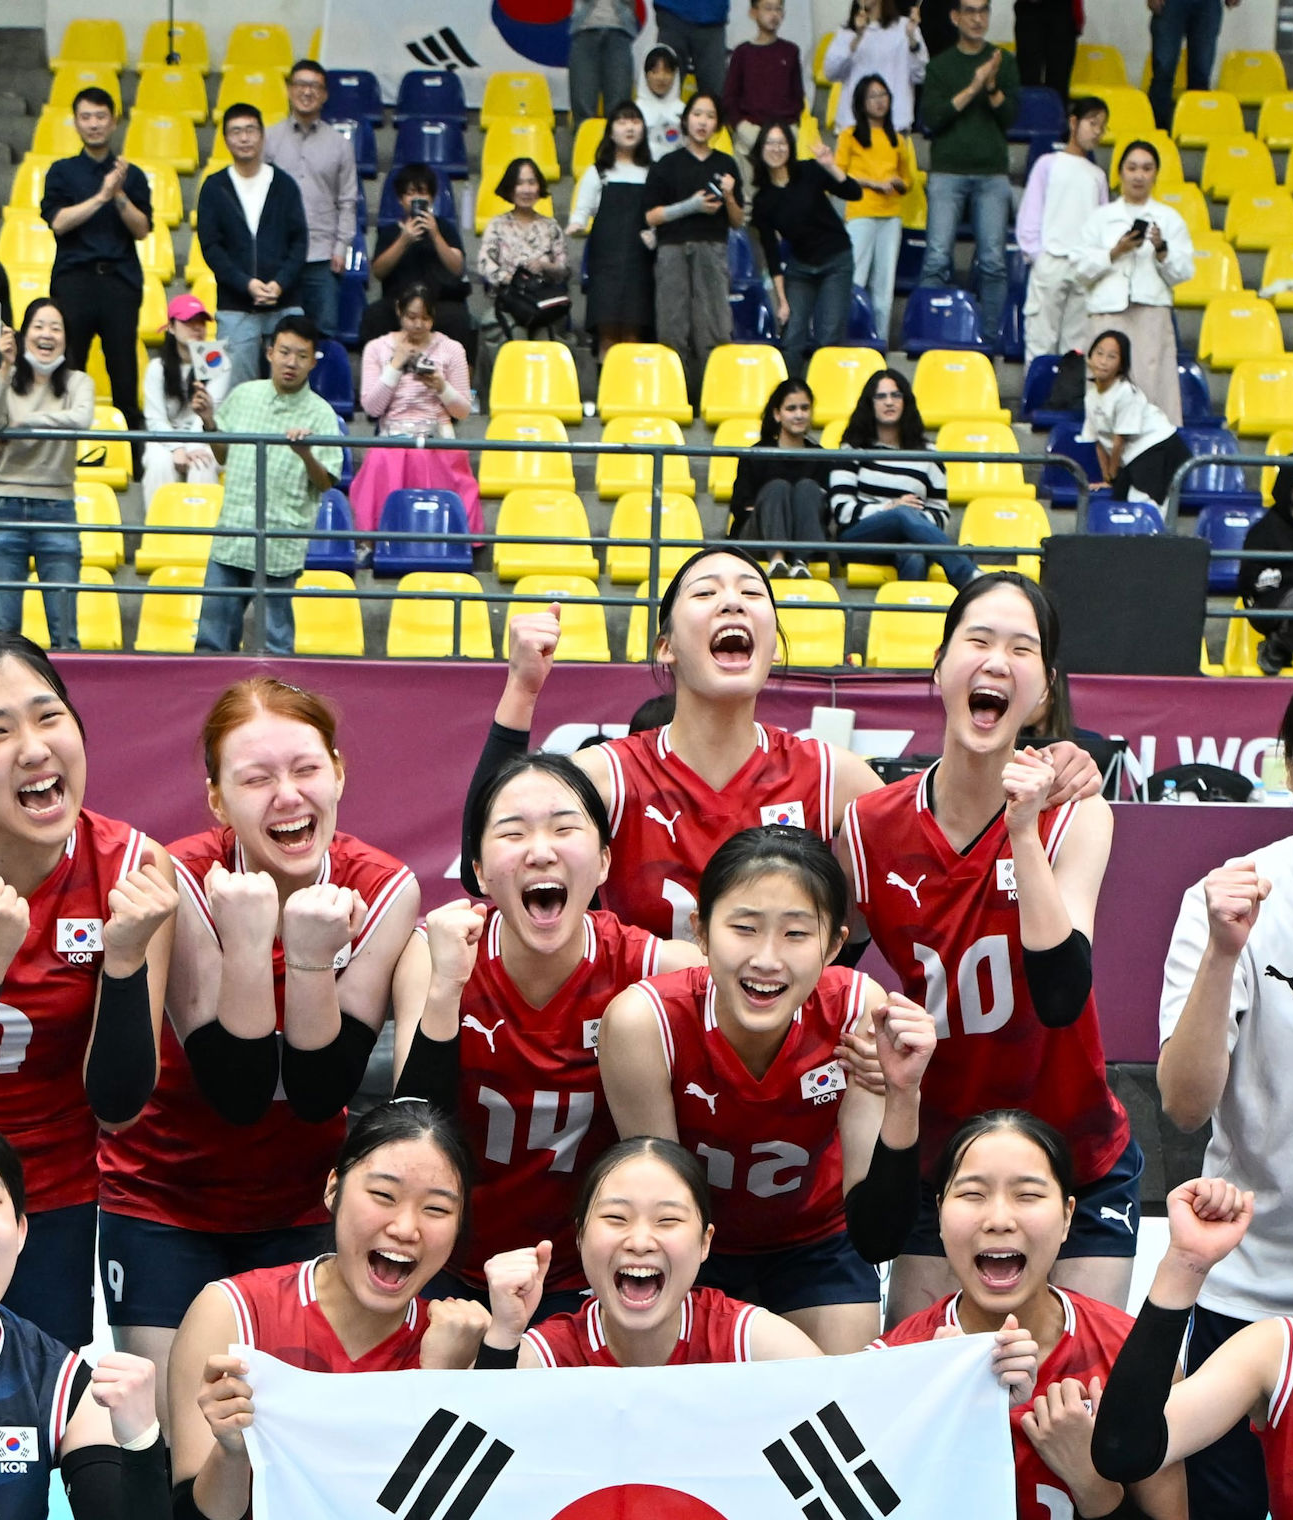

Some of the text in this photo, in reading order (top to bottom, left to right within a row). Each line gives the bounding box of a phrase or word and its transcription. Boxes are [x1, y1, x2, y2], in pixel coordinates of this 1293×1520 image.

[68, 951, 93, 964] KOR
[913, 935, 1014, 1040] 10
[813, 1092, 838, 1106] KOR
[478, 1086, 595, 1173] 14
[0, 1461, 28, 1474] KOR
